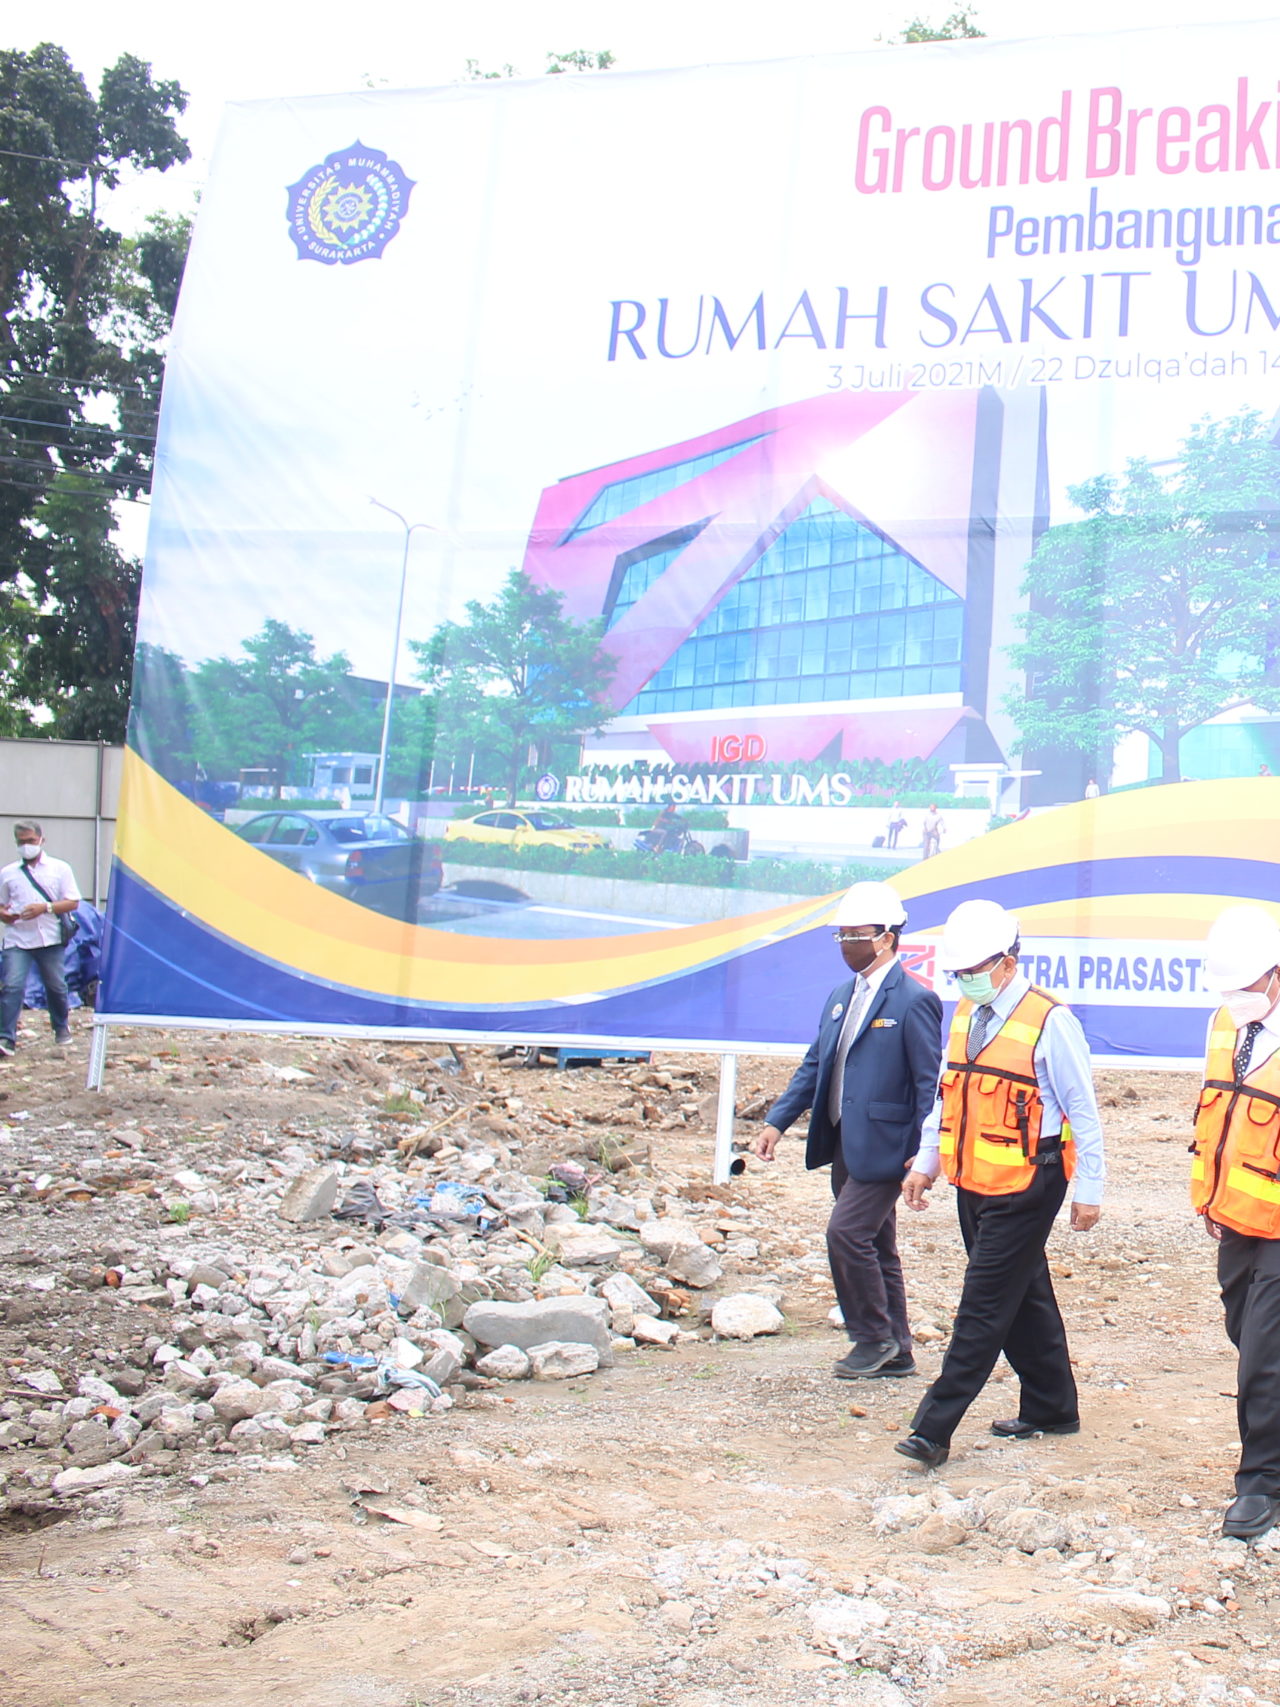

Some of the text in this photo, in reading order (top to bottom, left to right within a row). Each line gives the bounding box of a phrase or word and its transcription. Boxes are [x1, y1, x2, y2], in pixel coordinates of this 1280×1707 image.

[854, 89, 1073, 195] Ground
[296, 158, 401, 234] UNIVERSITAS MUHAMMADIYAH
[308, 241, 376, 259] SURAKARTA
[606, 285, 888, 362] RUMAH
[918, 271, 1152, 349] SAKIT
[826, 365, 843, 389] 3
[851, 363, 902, 389] Juli
[911, 361, 1002, 388] 2021M
[1030, 357, 1064, 383] 22
[1074, 350, 1248, 383] Dzulqa'dah
[711, 734, 767, 763] IGD
[566, 773, 853, 806] RUMAH SAKIT UMS
[1016, 955, 1072, 989] TRA
[1079, 956, 1209, 993] PRASAST
